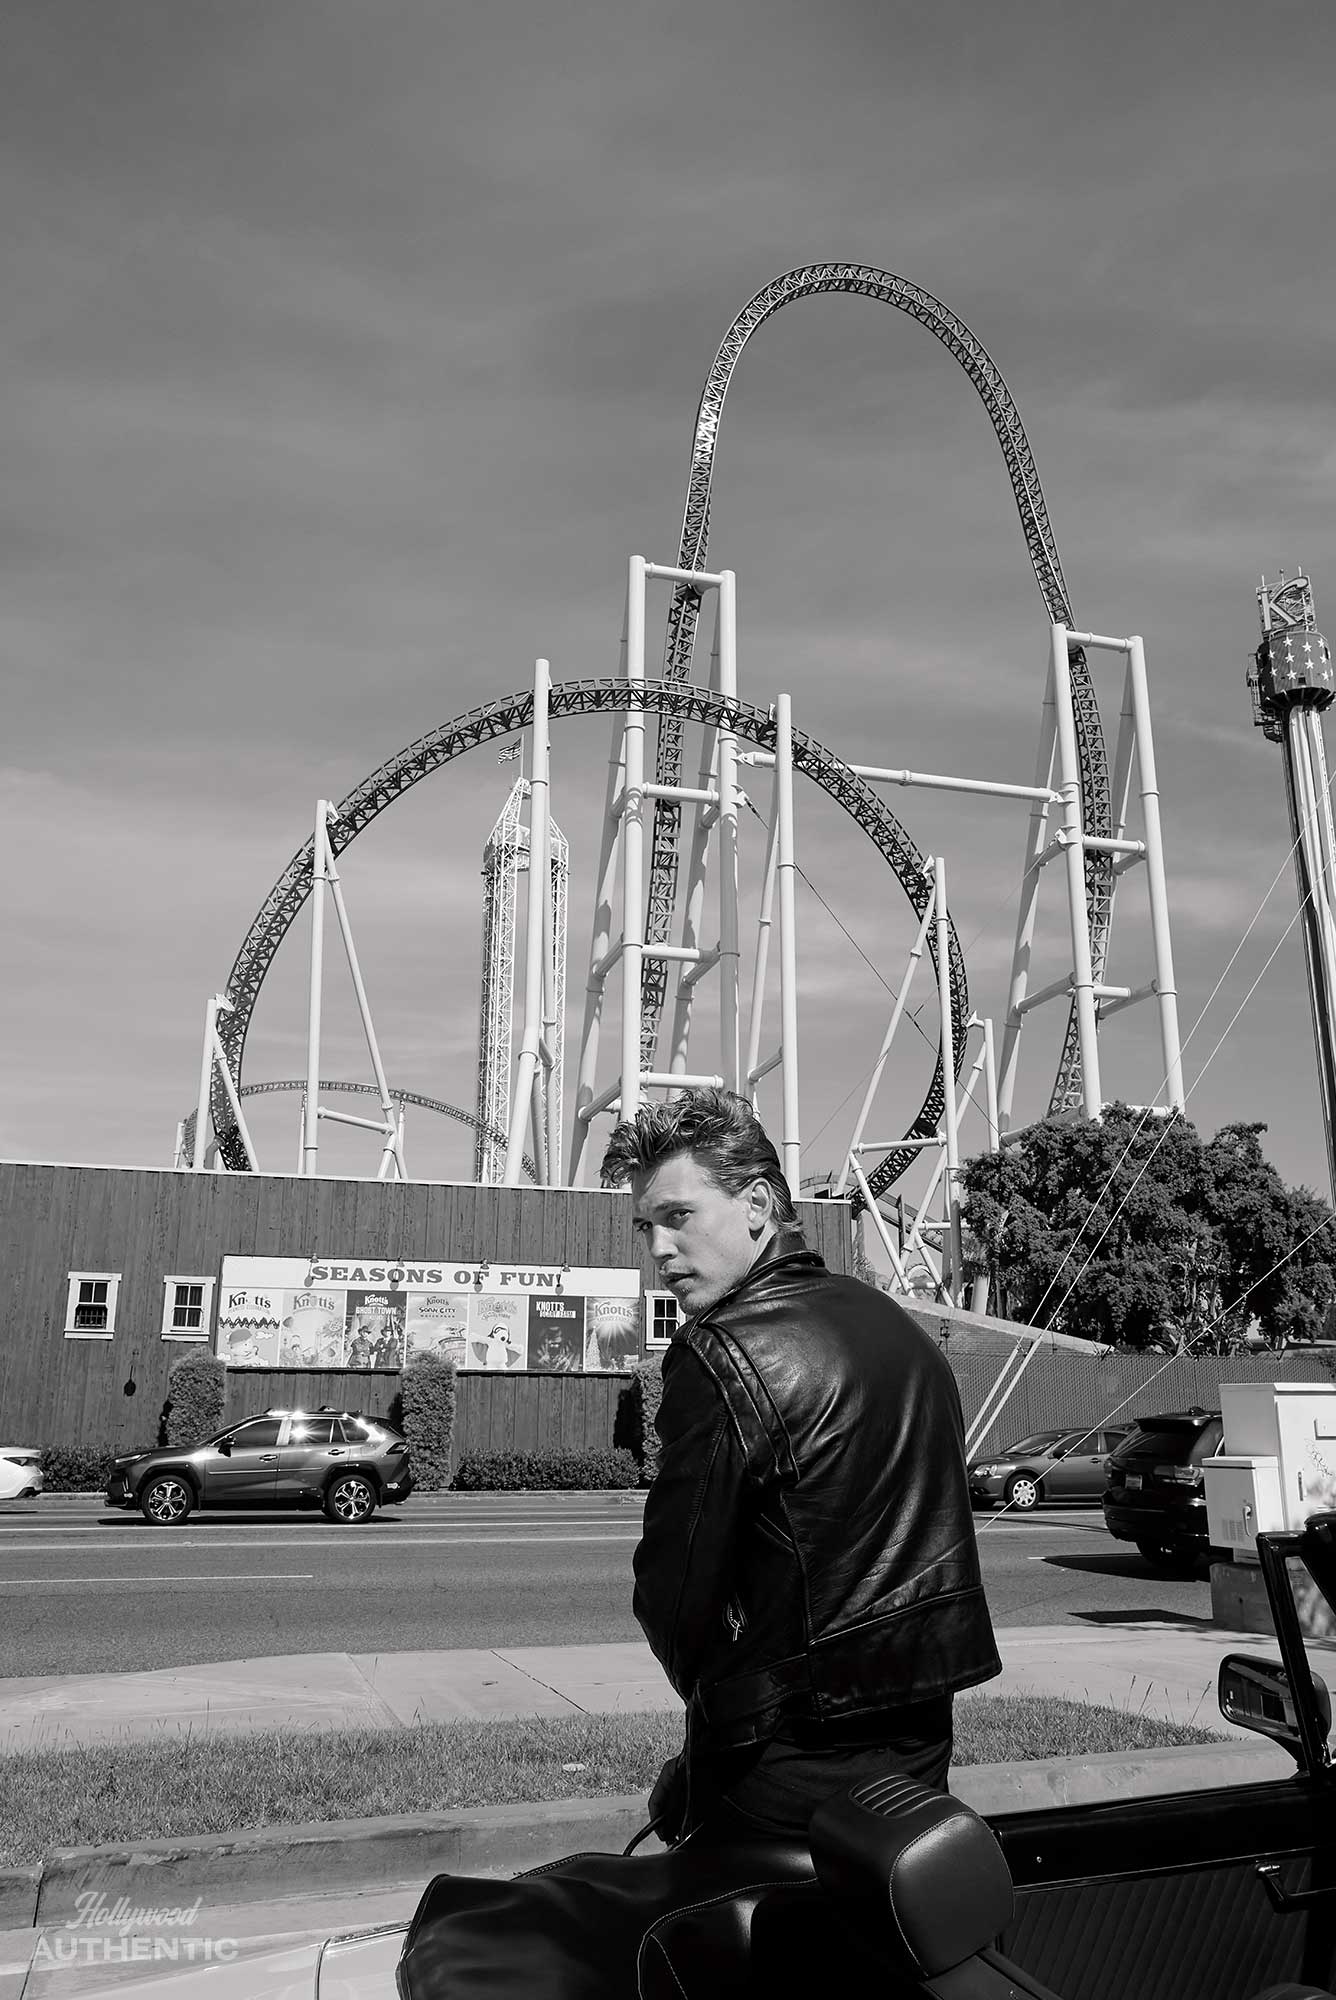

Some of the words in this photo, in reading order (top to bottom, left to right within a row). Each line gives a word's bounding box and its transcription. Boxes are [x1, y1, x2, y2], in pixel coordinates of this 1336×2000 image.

[311, 1265, 443, 1284] SEASONS
[453, 1270, 490, 1285] OF
[228, 1291, 271, 1309] Kntt's
[377, 1307, 397, 1315] TOWN
